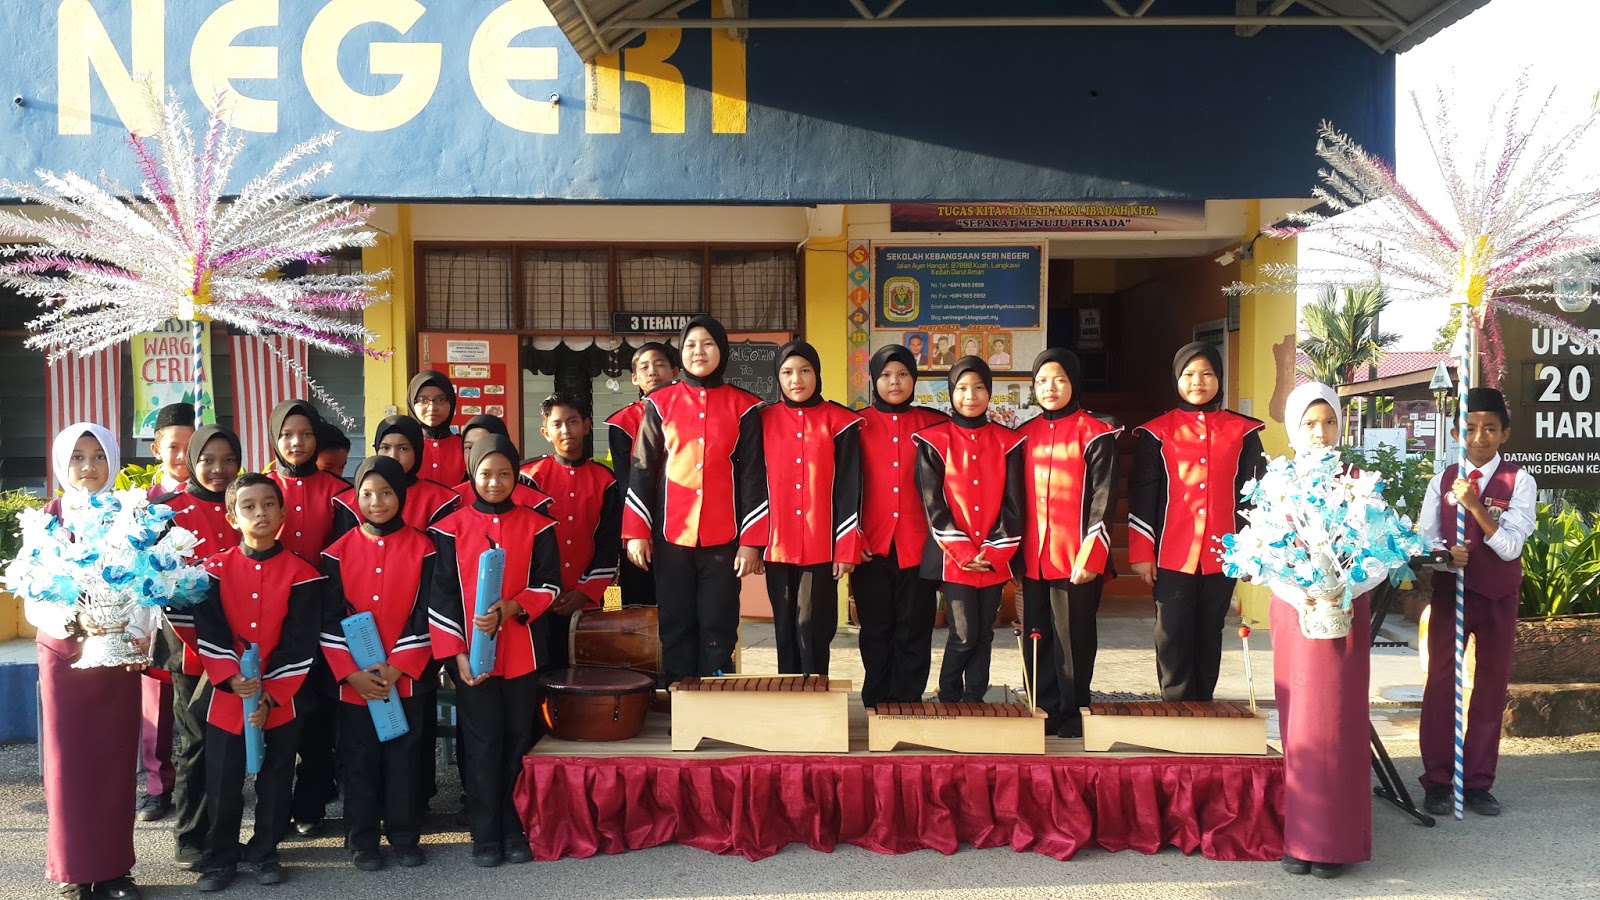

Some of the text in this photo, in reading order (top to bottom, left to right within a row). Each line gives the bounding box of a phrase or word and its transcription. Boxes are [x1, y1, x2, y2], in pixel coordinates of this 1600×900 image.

[58, 0, 746, 134] NEGERI
[938, 205, 1157, 216] TUGAS KITA ADALAH AMAL IBADAH KITA
[1018, 219, 1068, 228] MENUJU
[924, 252, 980, 260] KEBANGSAAN
[981, 252, 999, 260] SERI
[1001, 252, 1030, 260] NEGERI
[991, 261, 1020, 270] Langkawi
[630, 316, 691, 330] 3 TERATA
[144, 336, 195, 356] WARG
[1539, 365, 1591, 402] 20
[1504, 453, 1542, 462] DATANG
[1545, 453, 1584, 462] DENGAN
[1544, 465, 1584, 474] DENGAN
